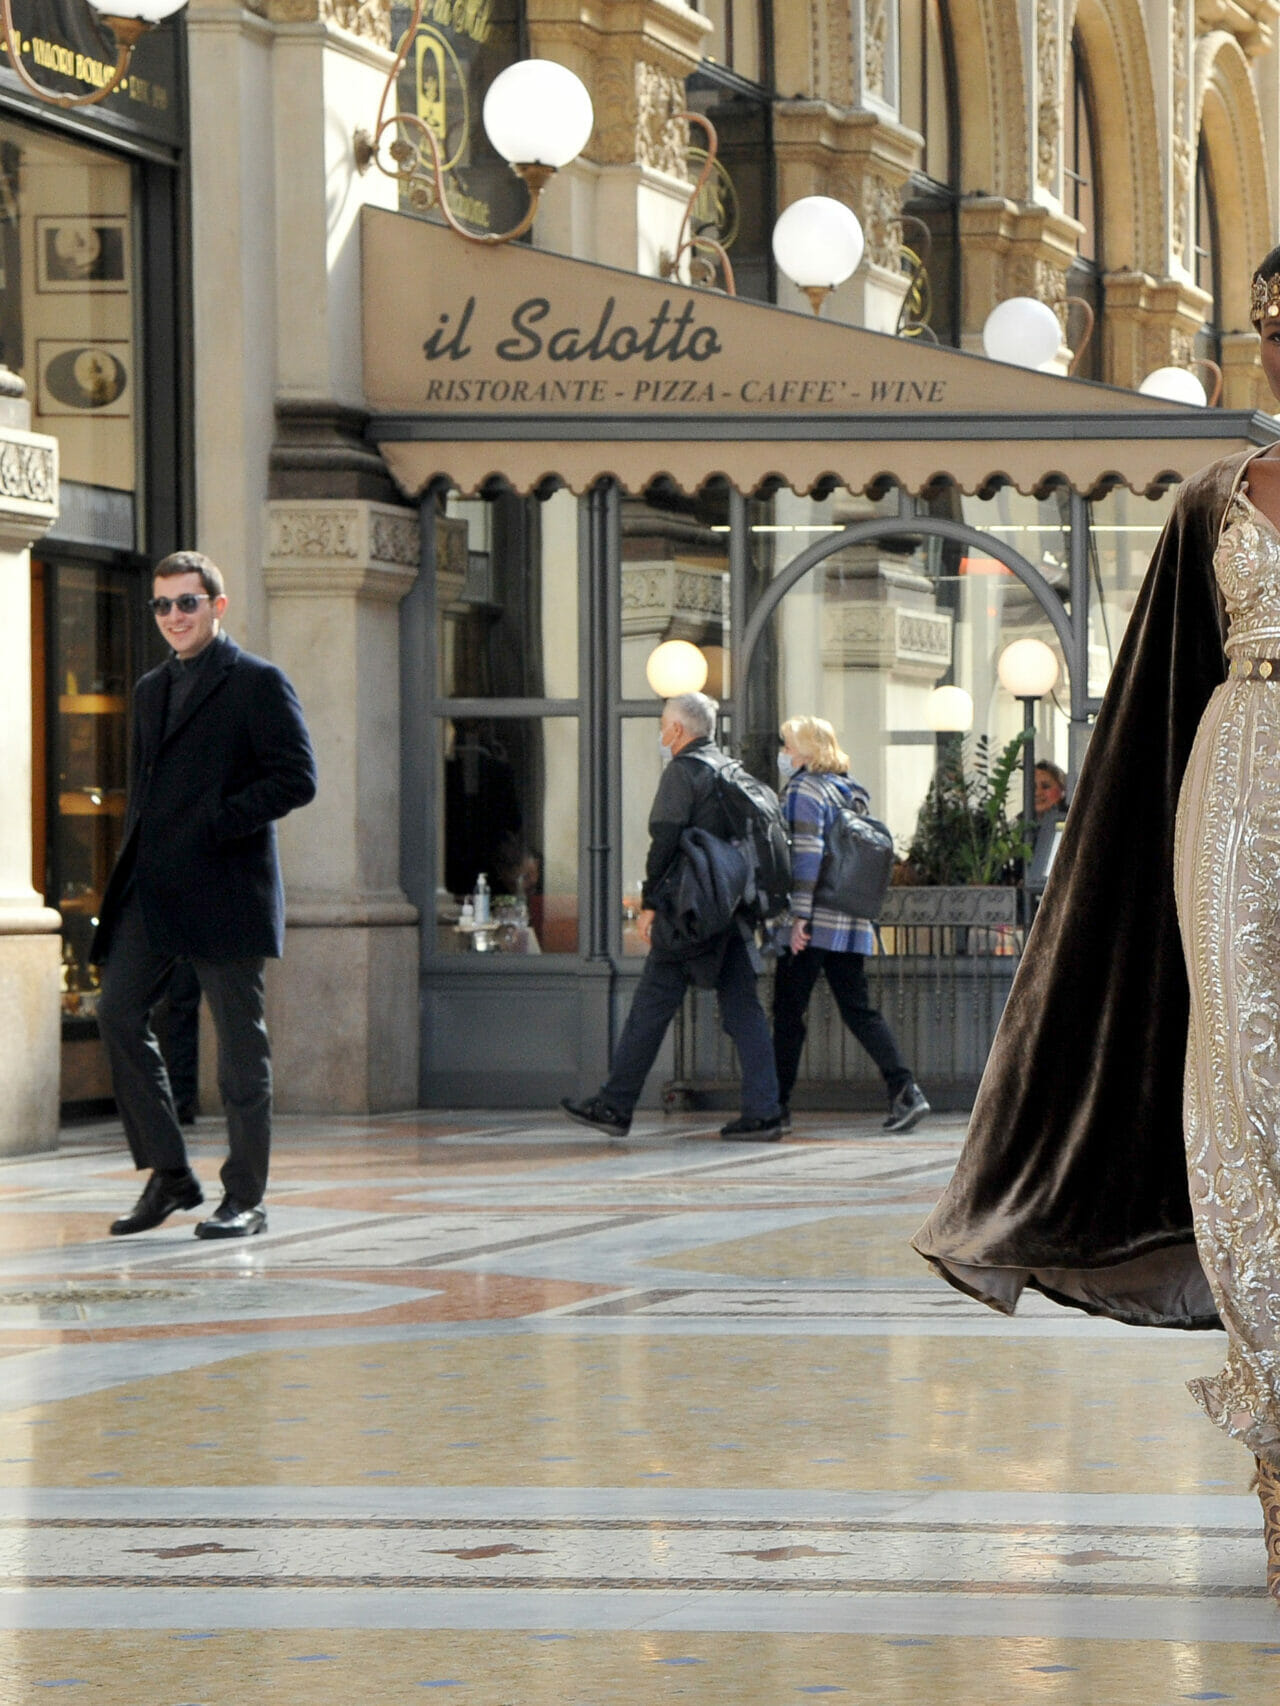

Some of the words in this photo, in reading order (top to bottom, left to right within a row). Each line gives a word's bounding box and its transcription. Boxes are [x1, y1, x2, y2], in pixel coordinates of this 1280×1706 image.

[422, 296, 476, 362] il
[495, 296, 723, 362] Salotto
[425, 379, 607, 402] RISTORANTE
[633, 380, 716, 403] PIZZA
[740, 380, 847, 403] CAFFE'
[870, 380, 947, 403] WINE
